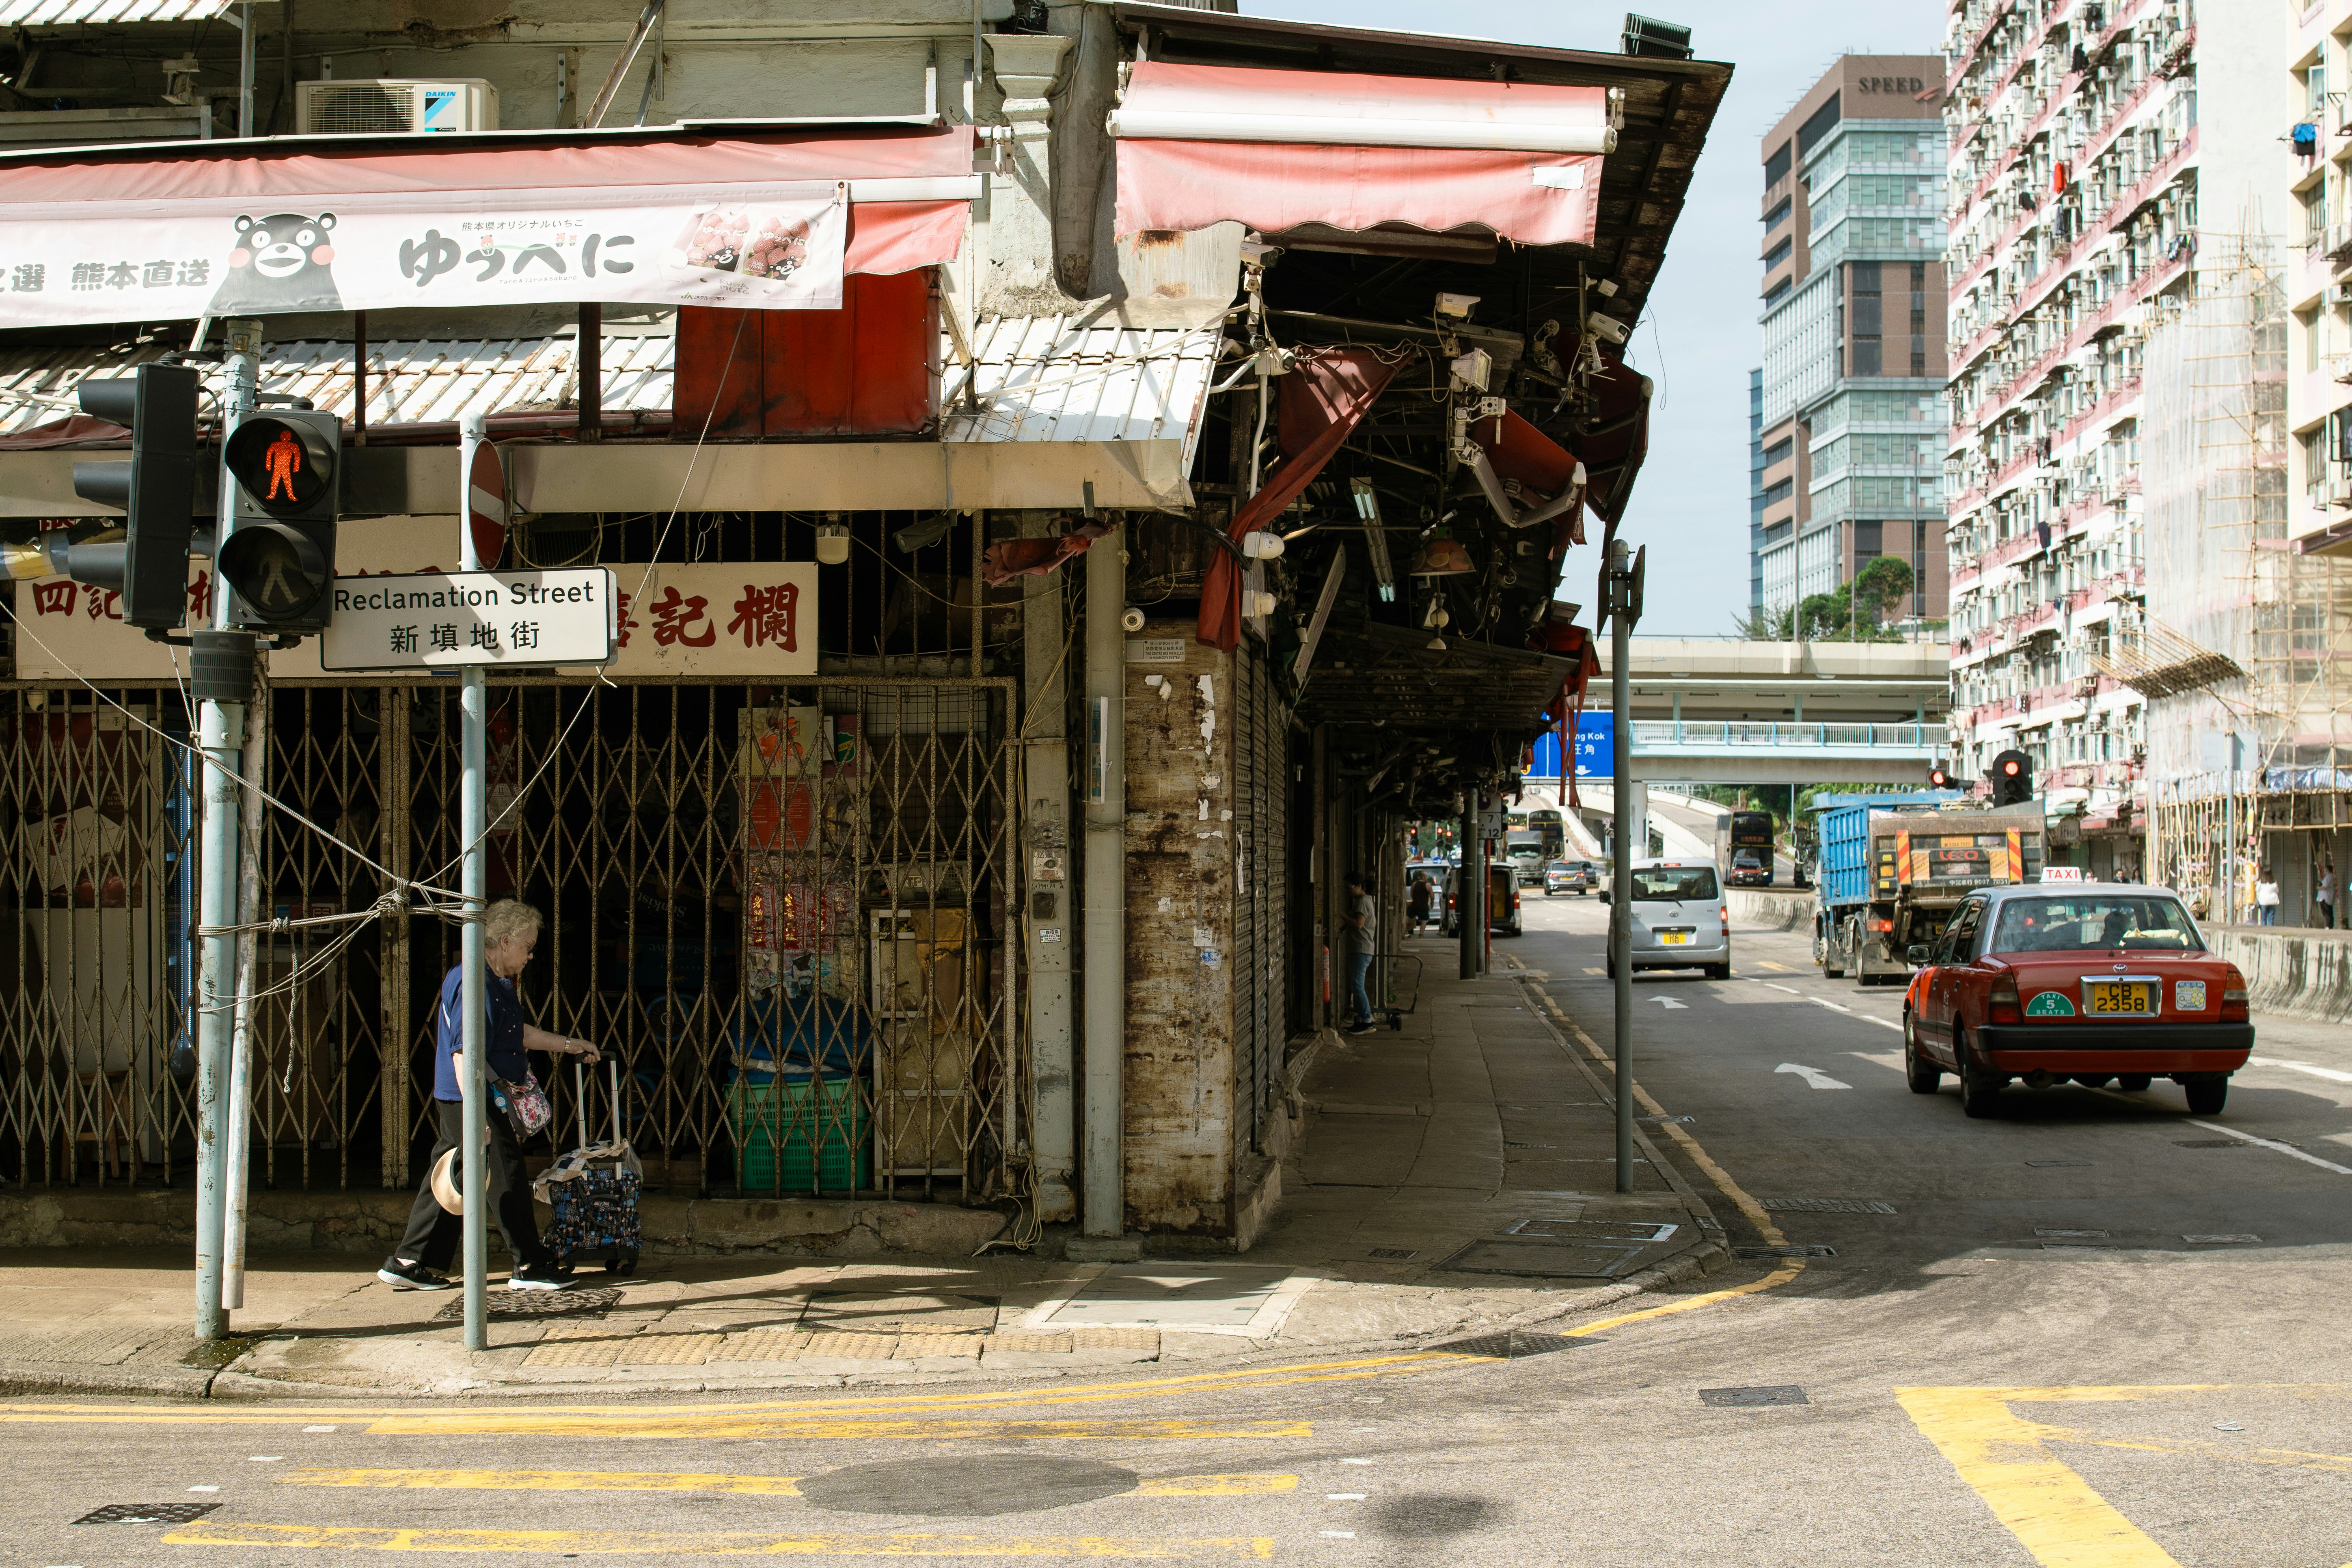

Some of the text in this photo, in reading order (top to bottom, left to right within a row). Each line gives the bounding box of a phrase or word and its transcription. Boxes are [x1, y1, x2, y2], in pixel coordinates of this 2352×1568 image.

[1859, 76, 1924, 93] SPEED
[462, 219, 584, 231] 熊本県オリジナルいちご
[0, 259, 209, 292] 選 熊本直送
[334, 580, 594, 612] Reclamation Street
[390, 621, 540, 654] 新填地街
[1588, 732, 1605, 740] Kok
[1487, 815, 1494, 823] 7
[1488, 829, 1499, 837] 12
[2046, 869, 2078, 879] TAXI
[2109, 984, 2132, 998] CB
[2046, 1000, 2055, 1009] 5
[2097, 997, 2145, 1012] 2358
